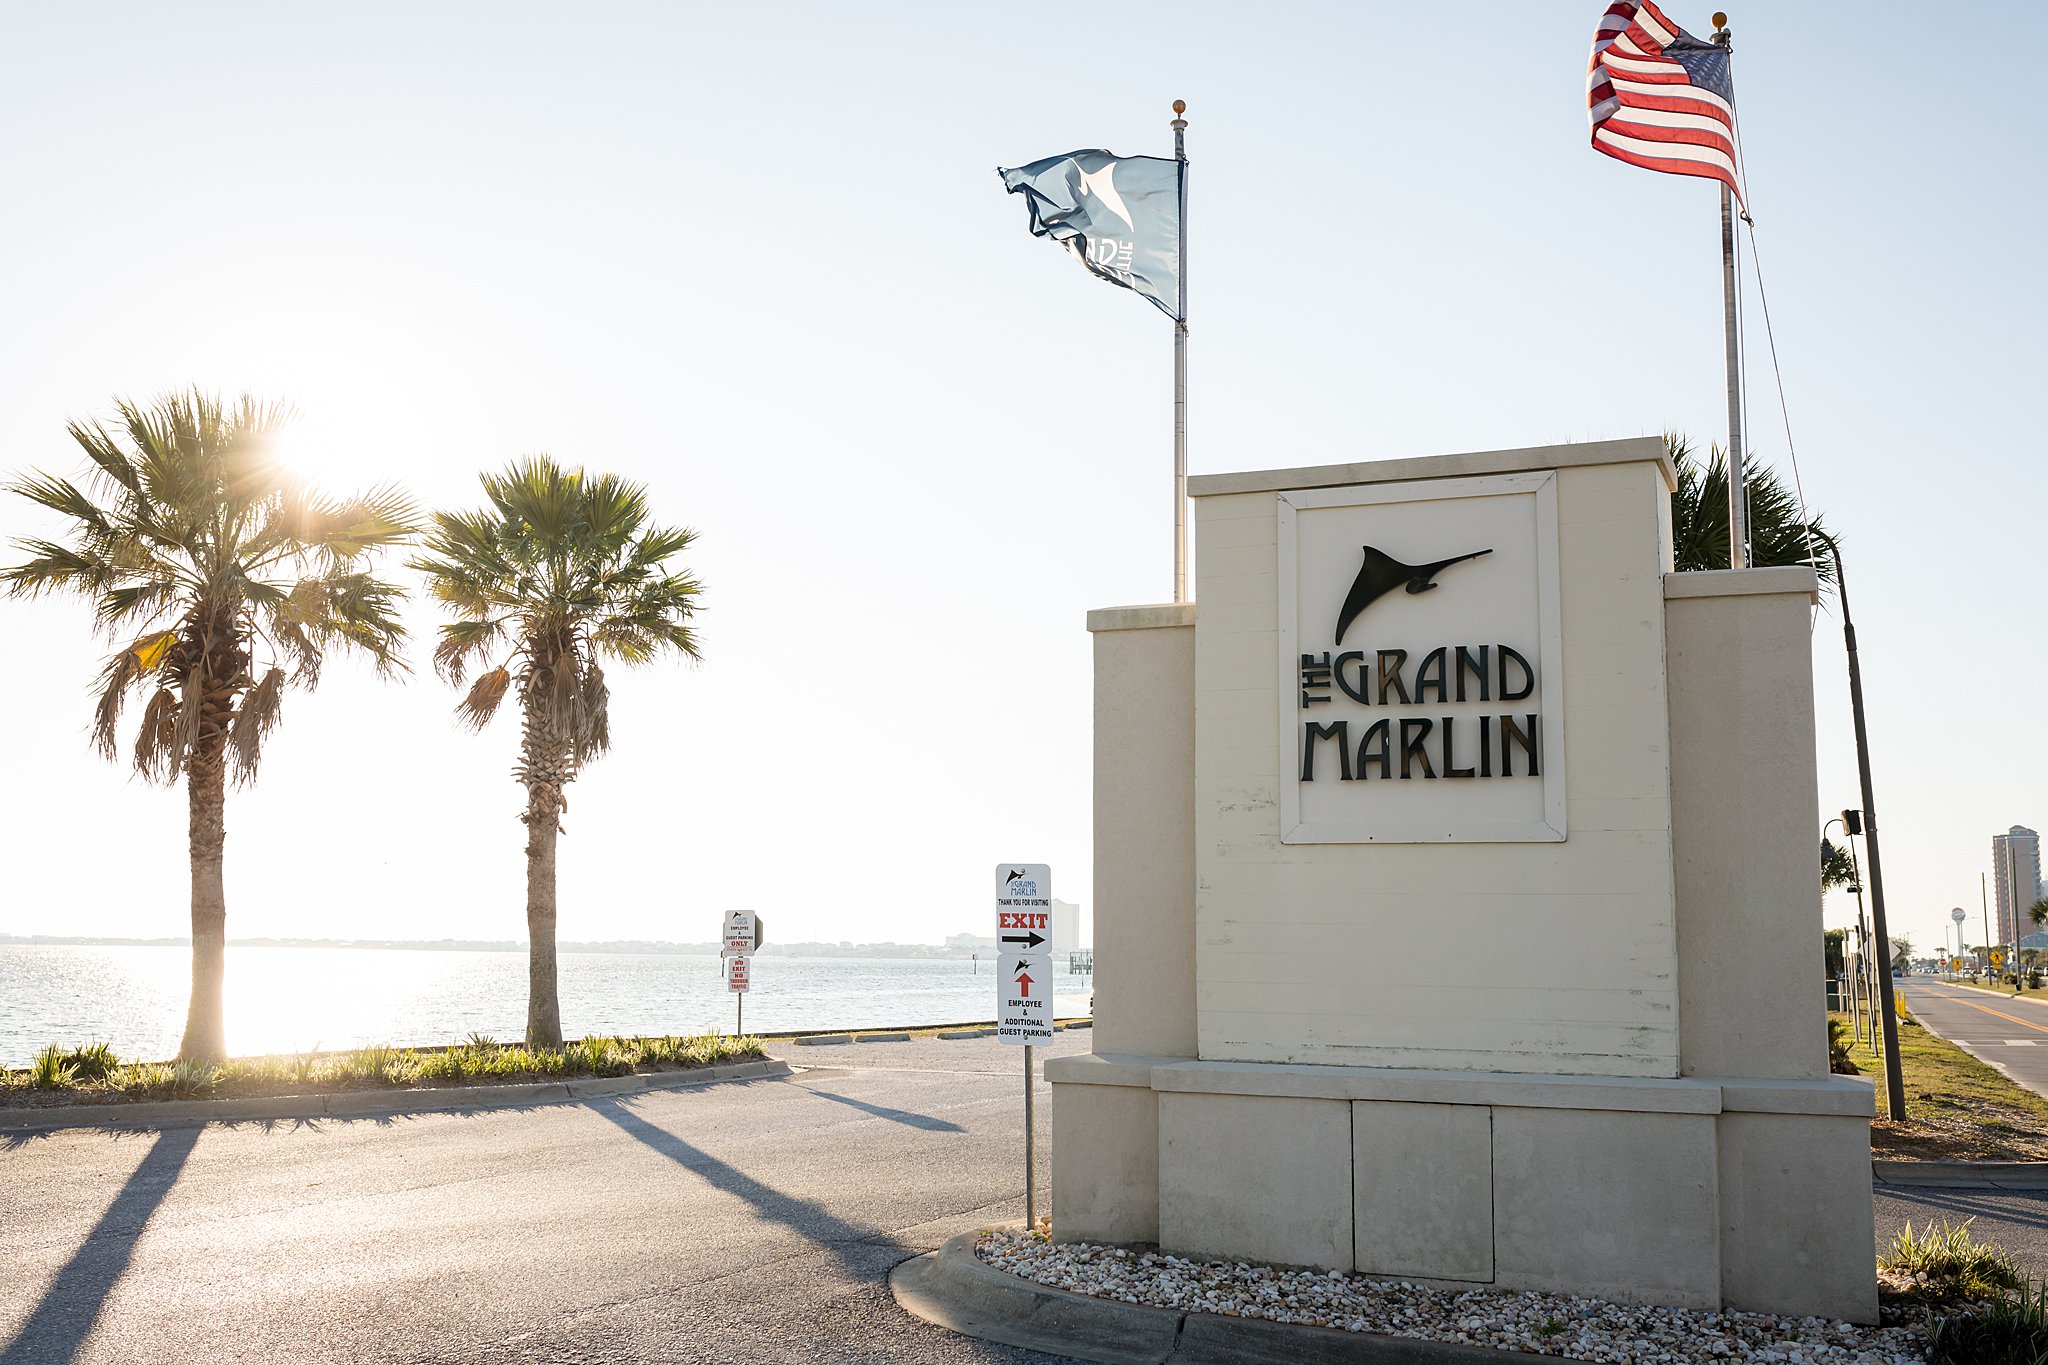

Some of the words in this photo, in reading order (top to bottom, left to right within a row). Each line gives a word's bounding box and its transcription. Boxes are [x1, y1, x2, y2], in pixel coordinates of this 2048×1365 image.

[1302, 652, 1331, 708] THE
[1334, 644, 1535, 706] GRAND
[1301, 714, 1539, 781] MARLIN
[1011, 888, 1037, 896] MARLIN
[1000, 913, 1048, 929] EXIT
[1008, 1000, 1042, 1008] EMPLOYEE
[1005, 1018, 1044, 1027] ADDITIONAL
[1023, 1029, 1052, 1037] PARKING
